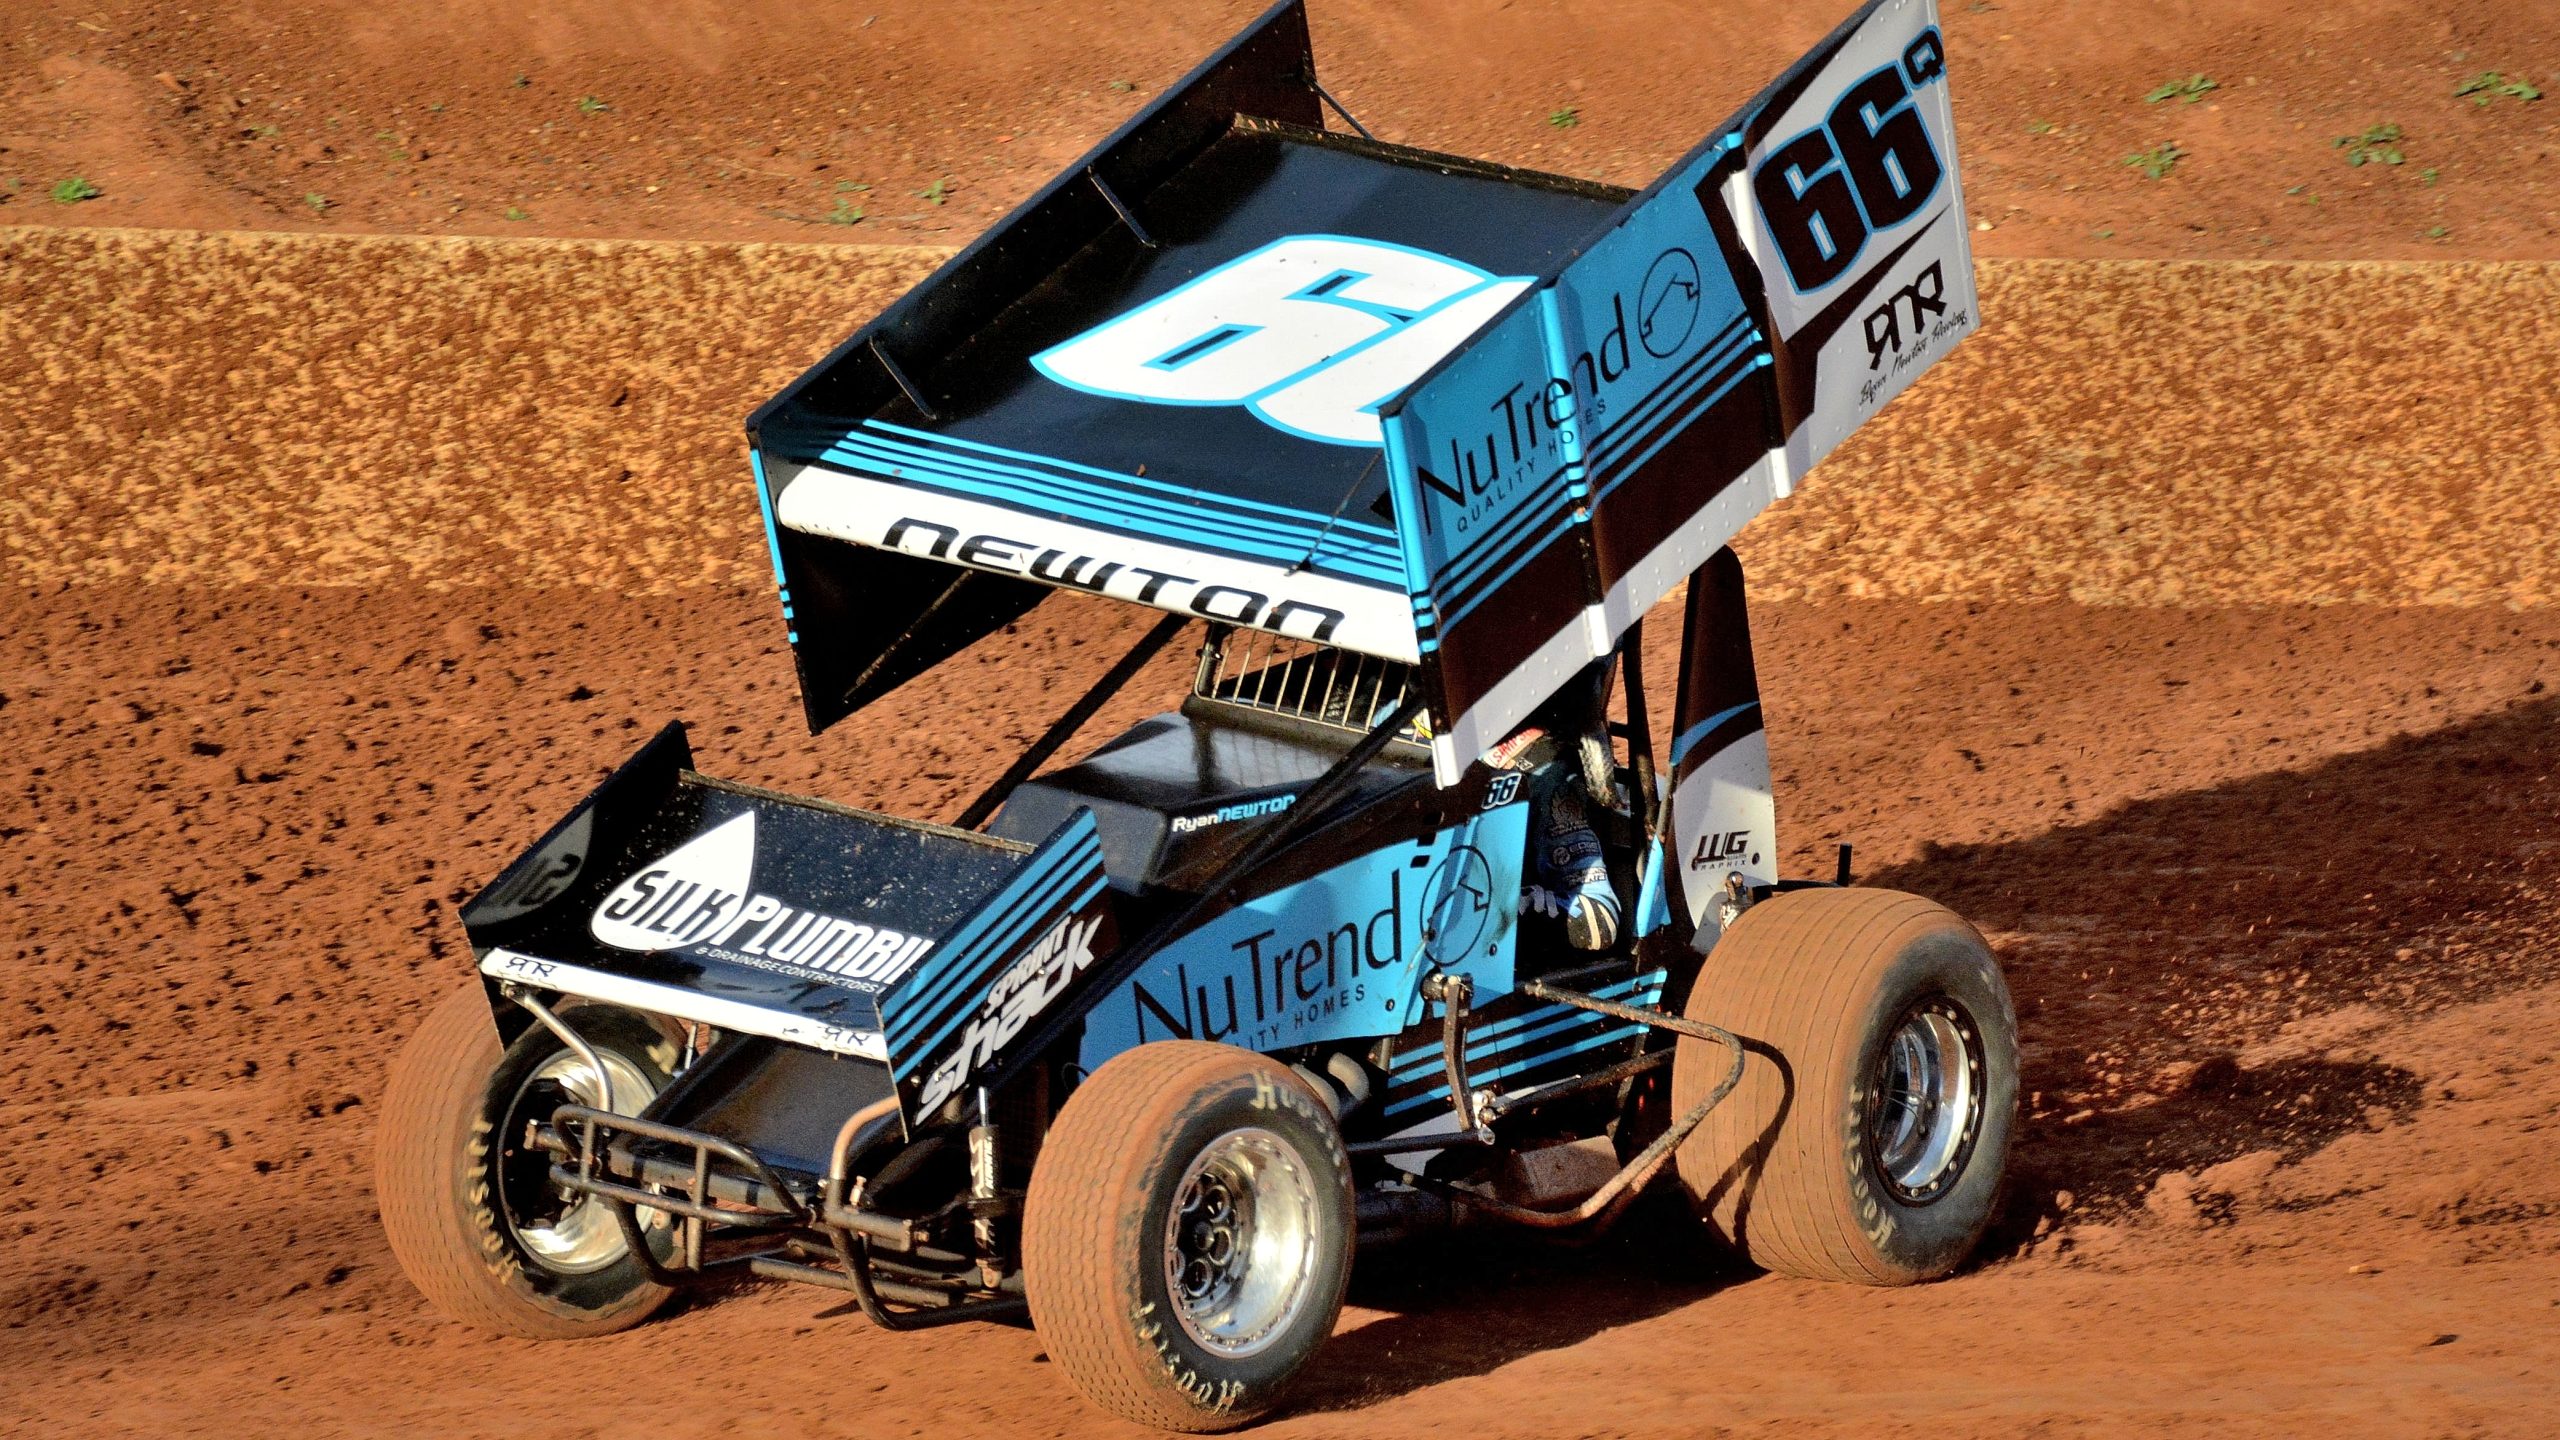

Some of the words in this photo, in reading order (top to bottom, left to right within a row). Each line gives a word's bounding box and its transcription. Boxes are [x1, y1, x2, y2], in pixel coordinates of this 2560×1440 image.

[1416, 292, 1631, 536] NuTrend
[1456, 457, 1537, 533] QUALITY
[1481, 772, 1523, 810] 66
[603, 869, 738, 943] SILK
[708, 947, 781, 973] DRAINAGE
[776, 964, 880, 994] CONTRACTORS
[983, 915, 1072, 1019] SPRINT
[1132, 868, 1403, 1045] NuTrend
[1294, 983, 1366, 1030] HOMES
